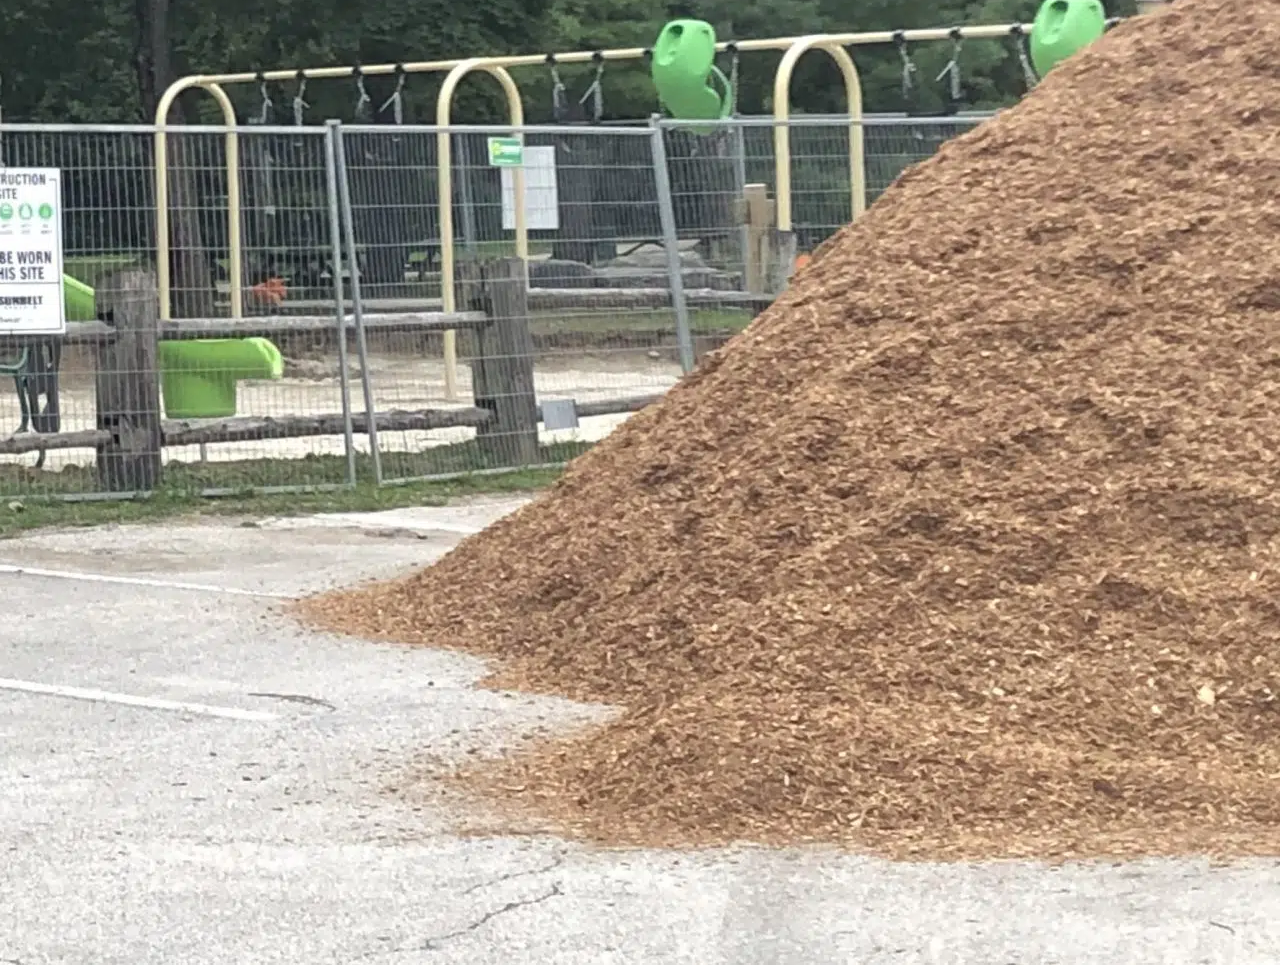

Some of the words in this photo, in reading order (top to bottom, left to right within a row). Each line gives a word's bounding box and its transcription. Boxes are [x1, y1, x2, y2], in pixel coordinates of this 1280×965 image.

[0, 250, 13, 264] BE
[17, 250, 52, 264] WORN
[20, 266, 44, 280] SITE
